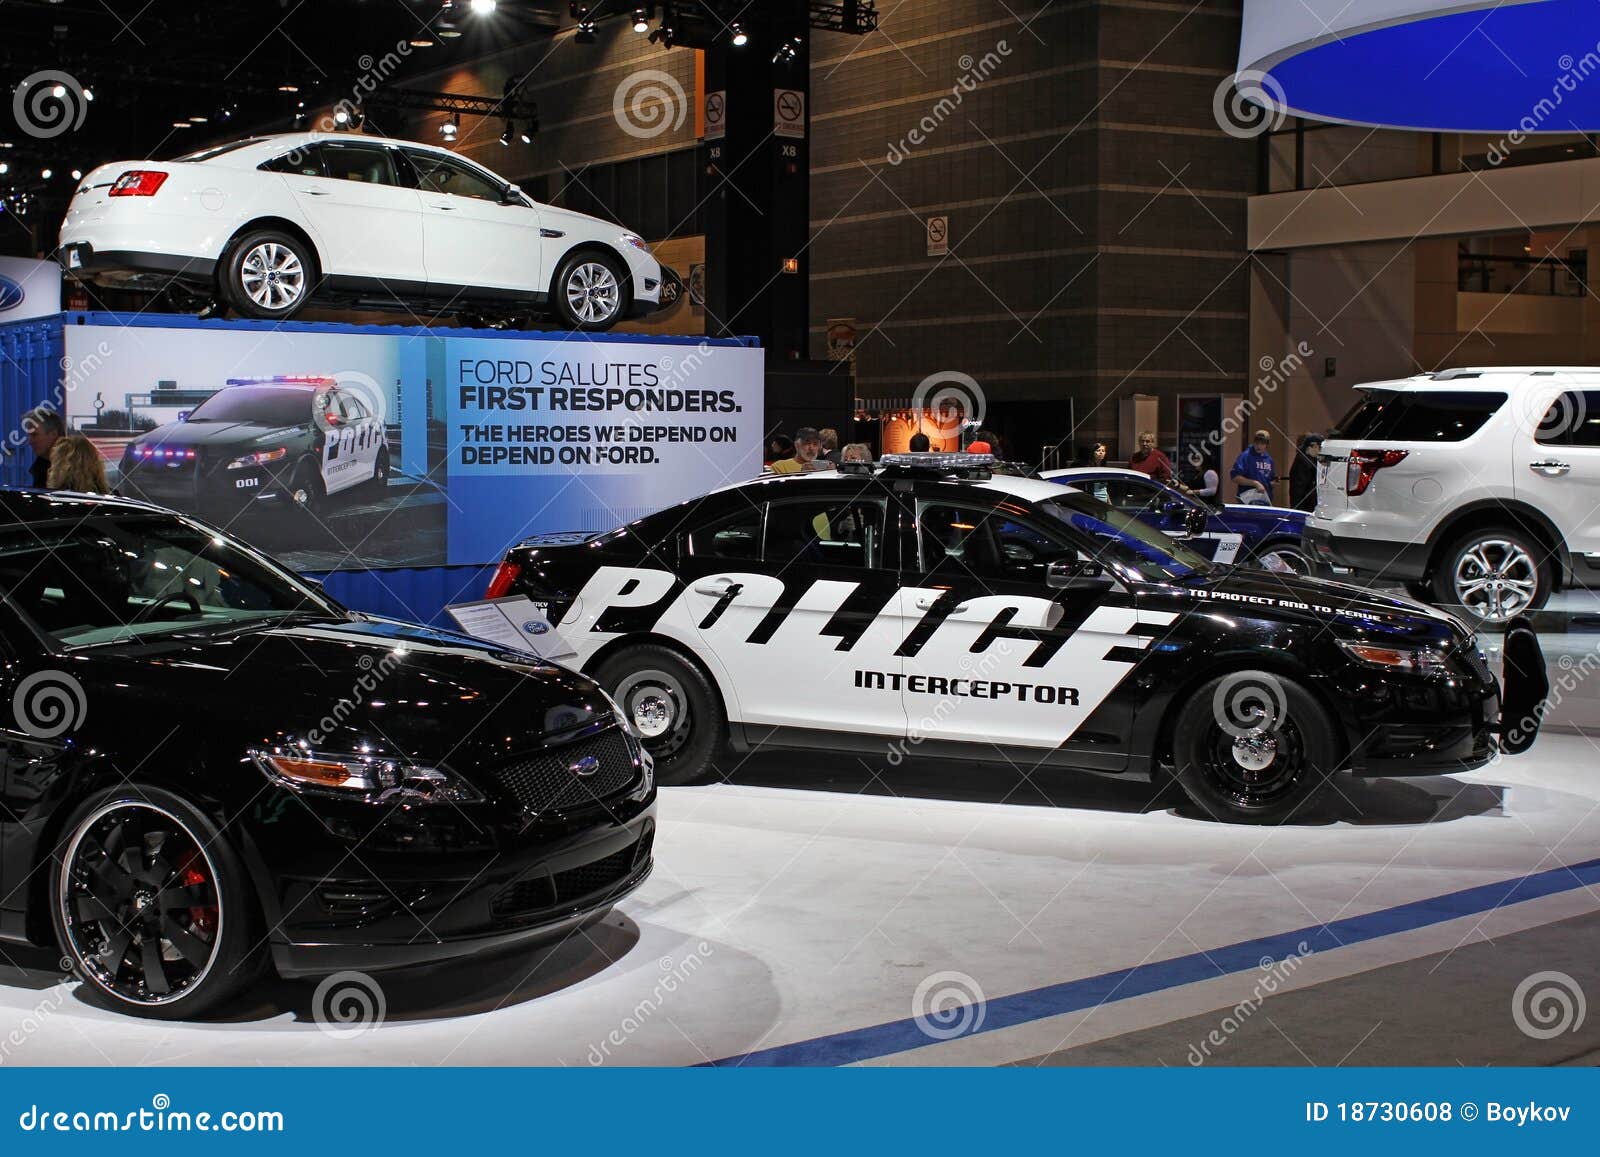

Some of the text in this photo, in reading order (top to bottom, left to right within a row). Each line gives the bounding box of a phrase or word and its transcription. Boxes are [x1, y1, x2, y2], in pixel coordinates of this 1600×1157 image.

[710, 147, 721, 159] X8
[782, 145, 797, 157] X8
[459, 359, 659, 387] FORD SALUTES
[459, 386, 545, 411] FIRST
[551, 387, 742, 413] RESPONDERS.
[460, 424, 737, 443] THE HEROES WE DEPEND ON
[461, 446, 660, 465] DEPEND ON FORD.
[570, 565, 1181, 668] POLICE
[1188, 588, 1382, 622] TO PROTECT AND TO SERVE
[853, 669, 1081, 706] INTERCEPTOR
